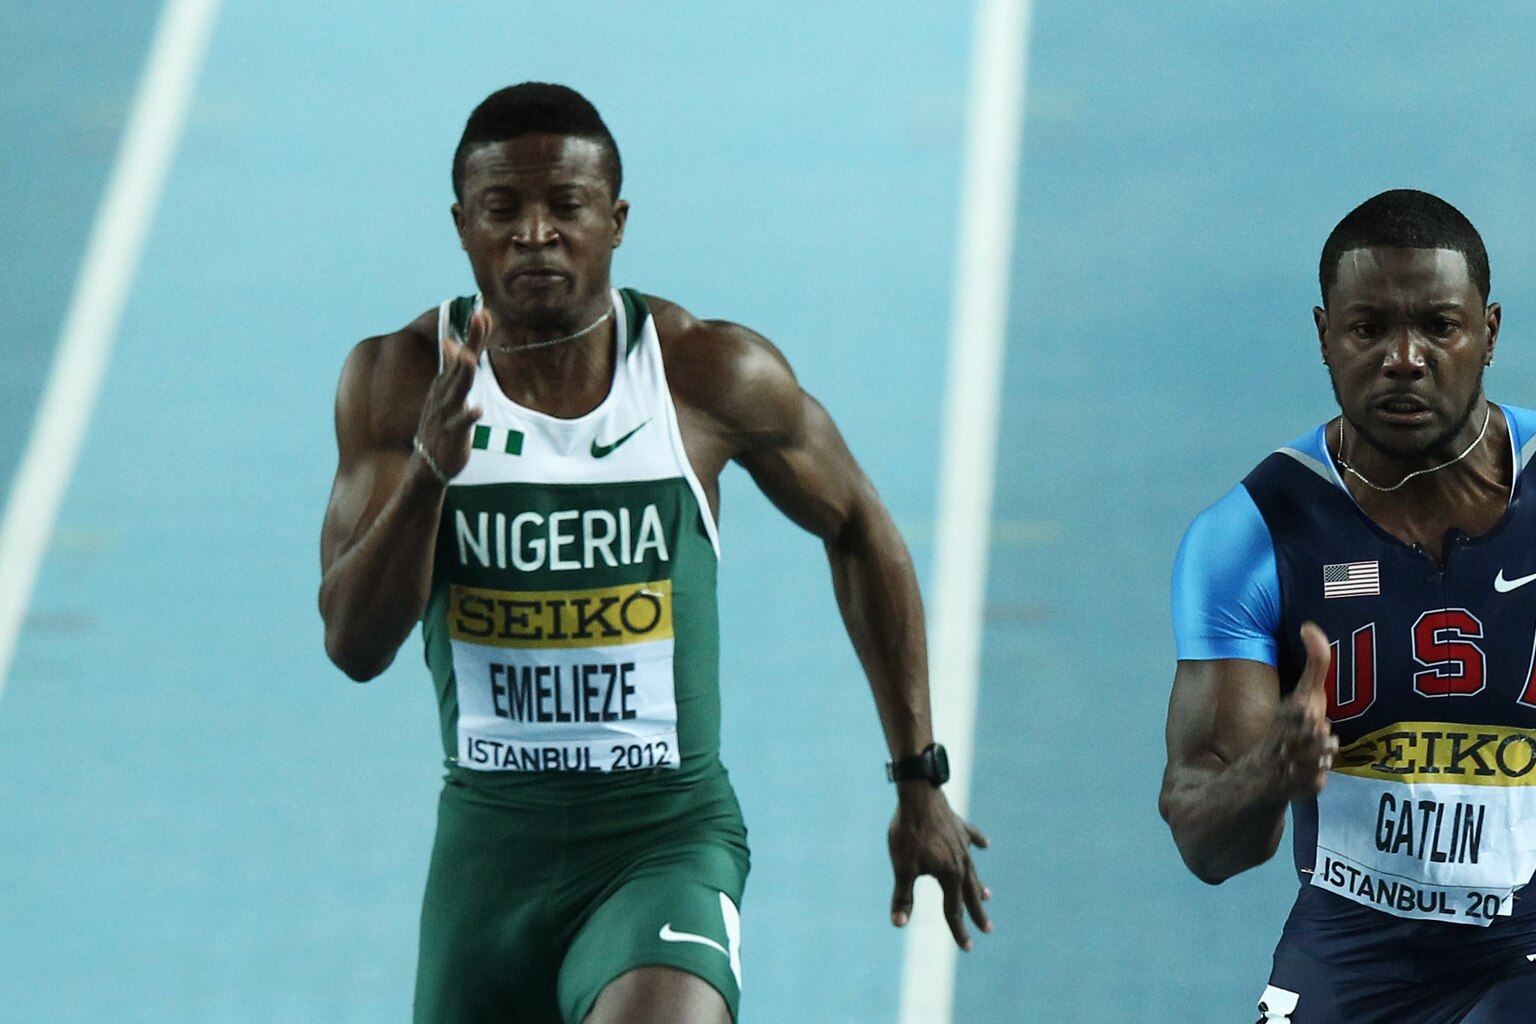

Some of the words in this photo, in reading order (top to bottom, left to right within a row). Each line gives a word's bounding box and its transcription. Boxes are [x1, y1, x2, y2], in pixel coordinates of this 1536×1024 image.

[454, 504, 669, 572] NIGERIA
[456, 589, 662, 641] SEIKO
[489, 662, 637, 723] EMELIEZE
[468, 737, 601, 772] ISTANBUL
[611, 741, 671, 771] 2012
[1375, 792, 1486, 865] GATLIN
[1323, 856, 1456, 915] ISTANBUL
[1465, 891, 1501, 920] 20
